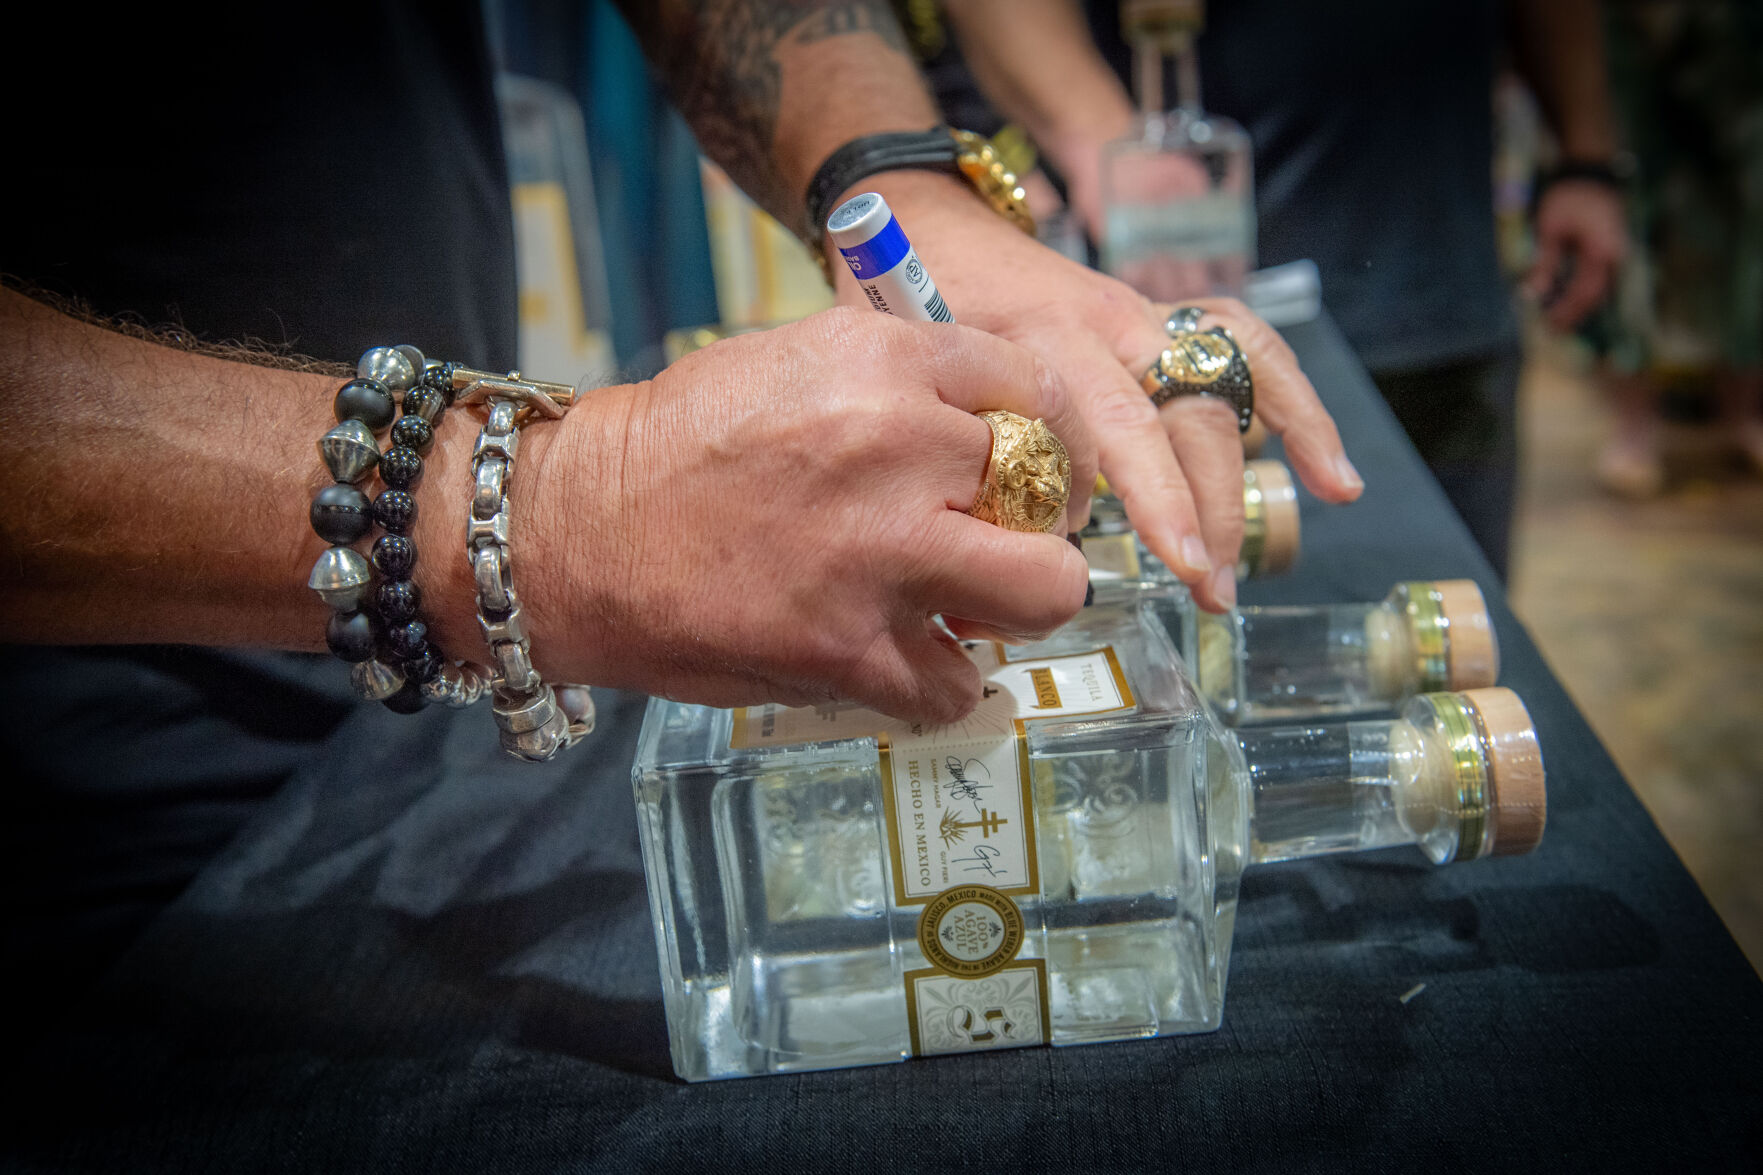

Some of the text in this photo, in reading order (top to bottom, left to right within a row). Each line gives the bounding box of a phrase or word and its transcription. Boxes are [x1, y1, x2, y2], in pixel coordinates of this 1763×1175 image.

[868, 284, 894, 316] YENNE
[1033, 669, 1058, 707] BLANCO
[1080, 663, 1105, 702] TEQUILA
[908, 760, 931, 887] HECHO EN MEXICO
[946, 890, 976, 903] MEXICO
[954, 915, 967, 951] AZUL
[964, 909, 979, 954] AGAVE
[1004, 911, 1018, 929] BLUE
